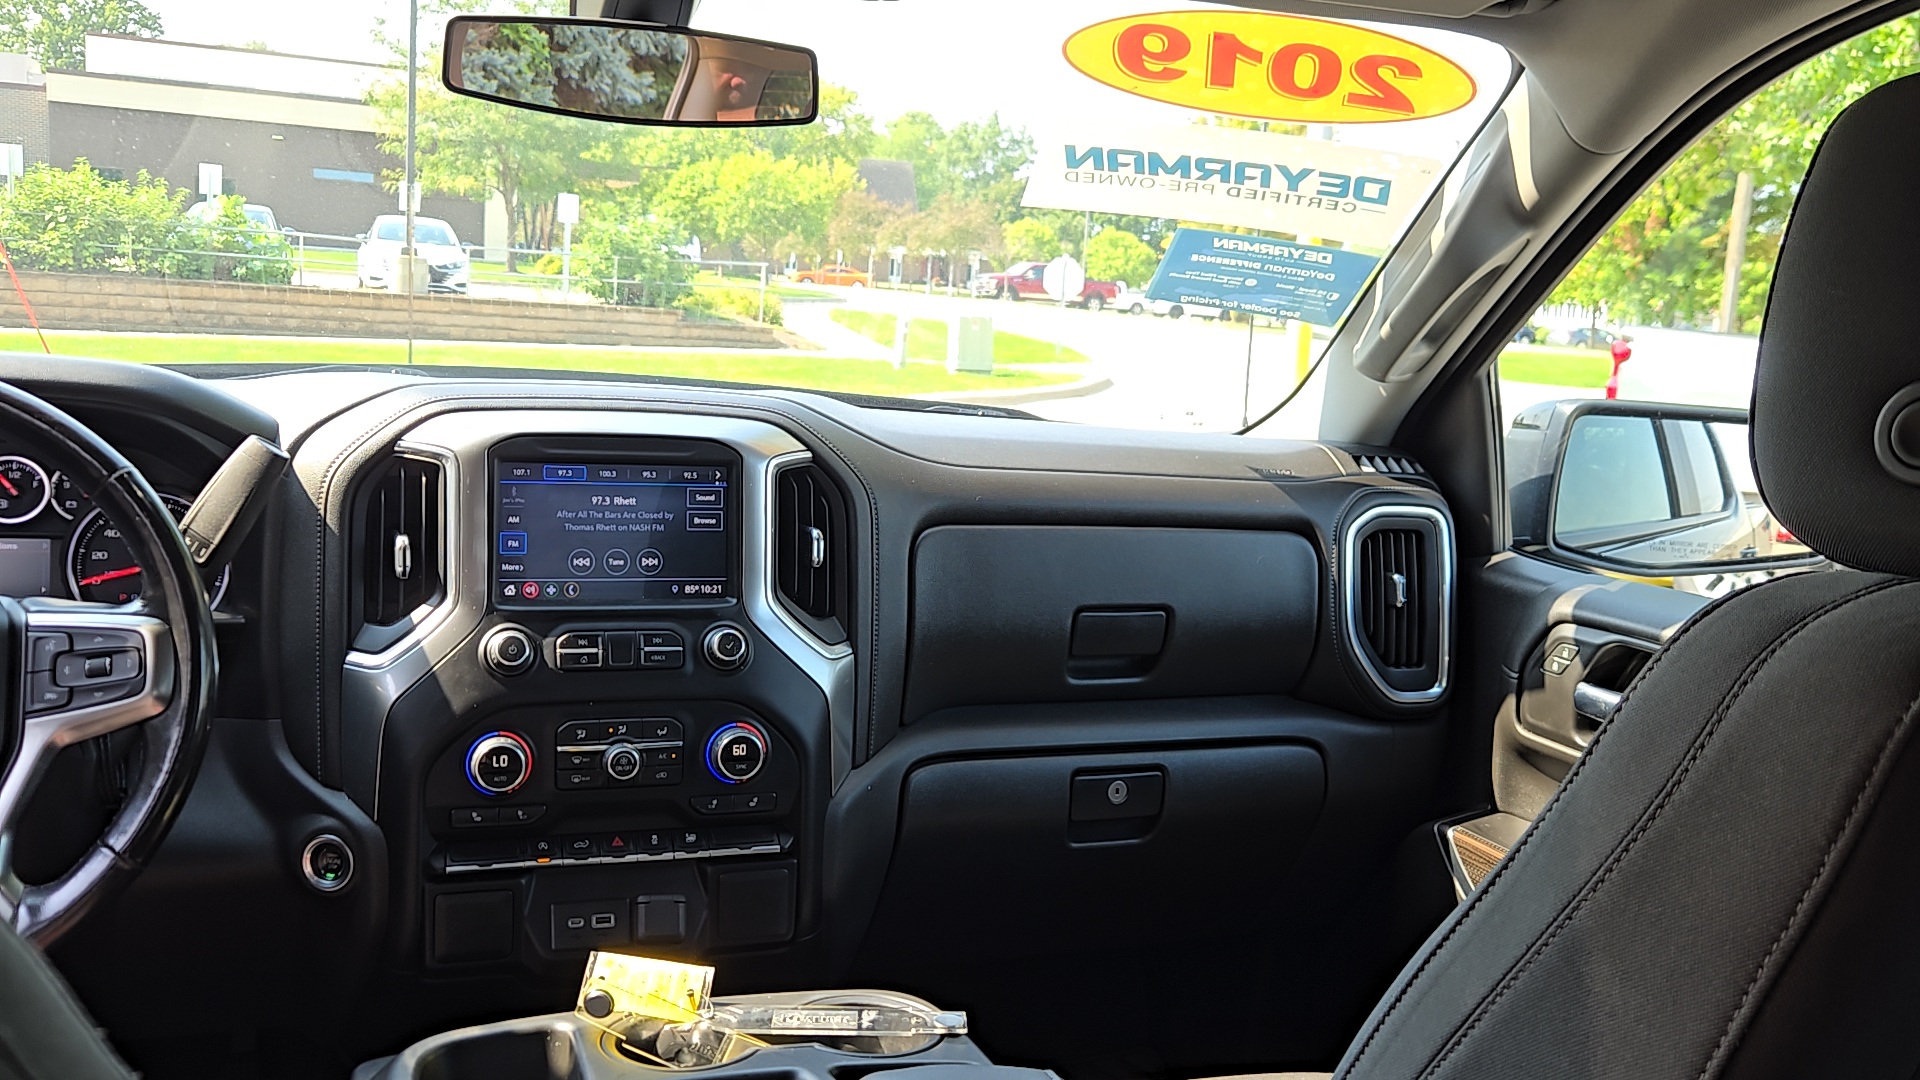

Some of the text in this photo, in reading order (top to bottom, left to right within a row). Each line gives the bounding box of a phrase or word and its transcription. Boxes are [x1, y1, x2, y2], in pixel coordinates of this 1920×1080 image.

[512, 468, 531, 477] 107.1
[557, 469, 573, 478] 97.3
[598, 470, 617, 479] 100.3
[641, 470, 657, 479] 95.3
[683, 471, 698, 480] 92.5
[591, 496, 637, 506] 97.3 Rhett
[695, 493, 715, 502] Sound
[507, 515, 520, 524] AM
[556, 510, 674, 522] After All The Bars Are Closed by
[693, 516, 717, 526] Browse
[564, 523, 594, 532] Thomas
[595, 523, 616, 532] Rhett
[629, 523, 651, 533] NASH
[652, 524, 665, 533] FM
[104, 529, 121, 538] 40
[507, 540, 520, 548] FM
[91, 551, 108, 560] 20
[608, 558, 625, 566] Tune
[501, 563, 520, 572] More
[701, 584, 722, 594] 10:21
[731, 743, 747, 756] 60
[492, 754, 508, 768] LO
